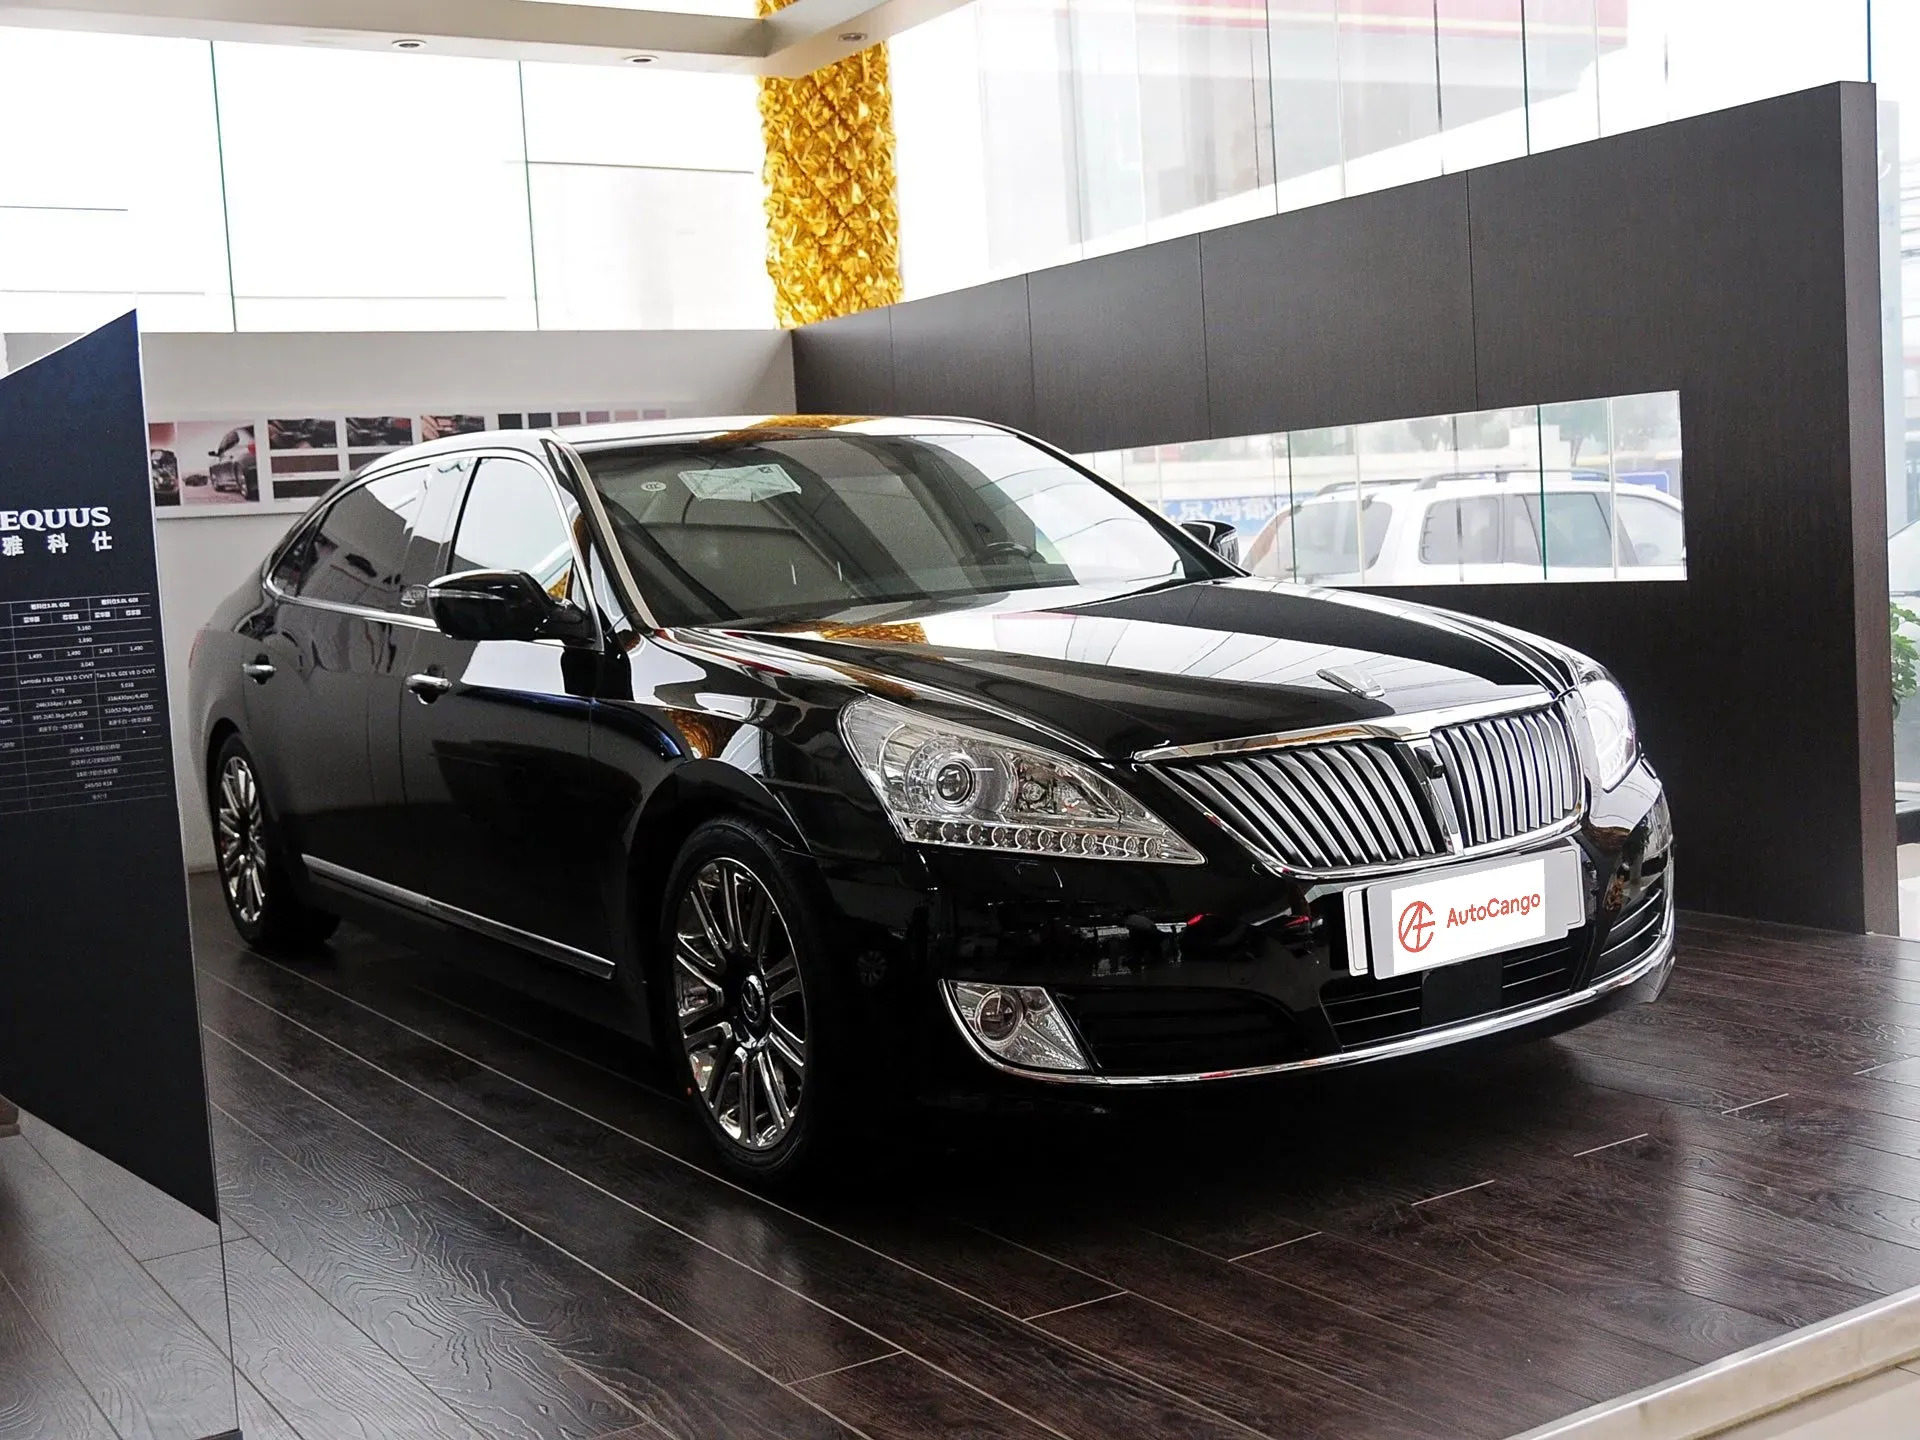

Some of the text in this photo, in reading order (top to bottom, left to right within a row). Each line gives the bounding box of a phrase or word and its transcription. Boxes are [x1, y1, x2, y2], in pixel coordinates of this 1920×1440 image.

[0, 507, 111, 531] EQUUS
[2, 531, 113, 556] 雅科仕
